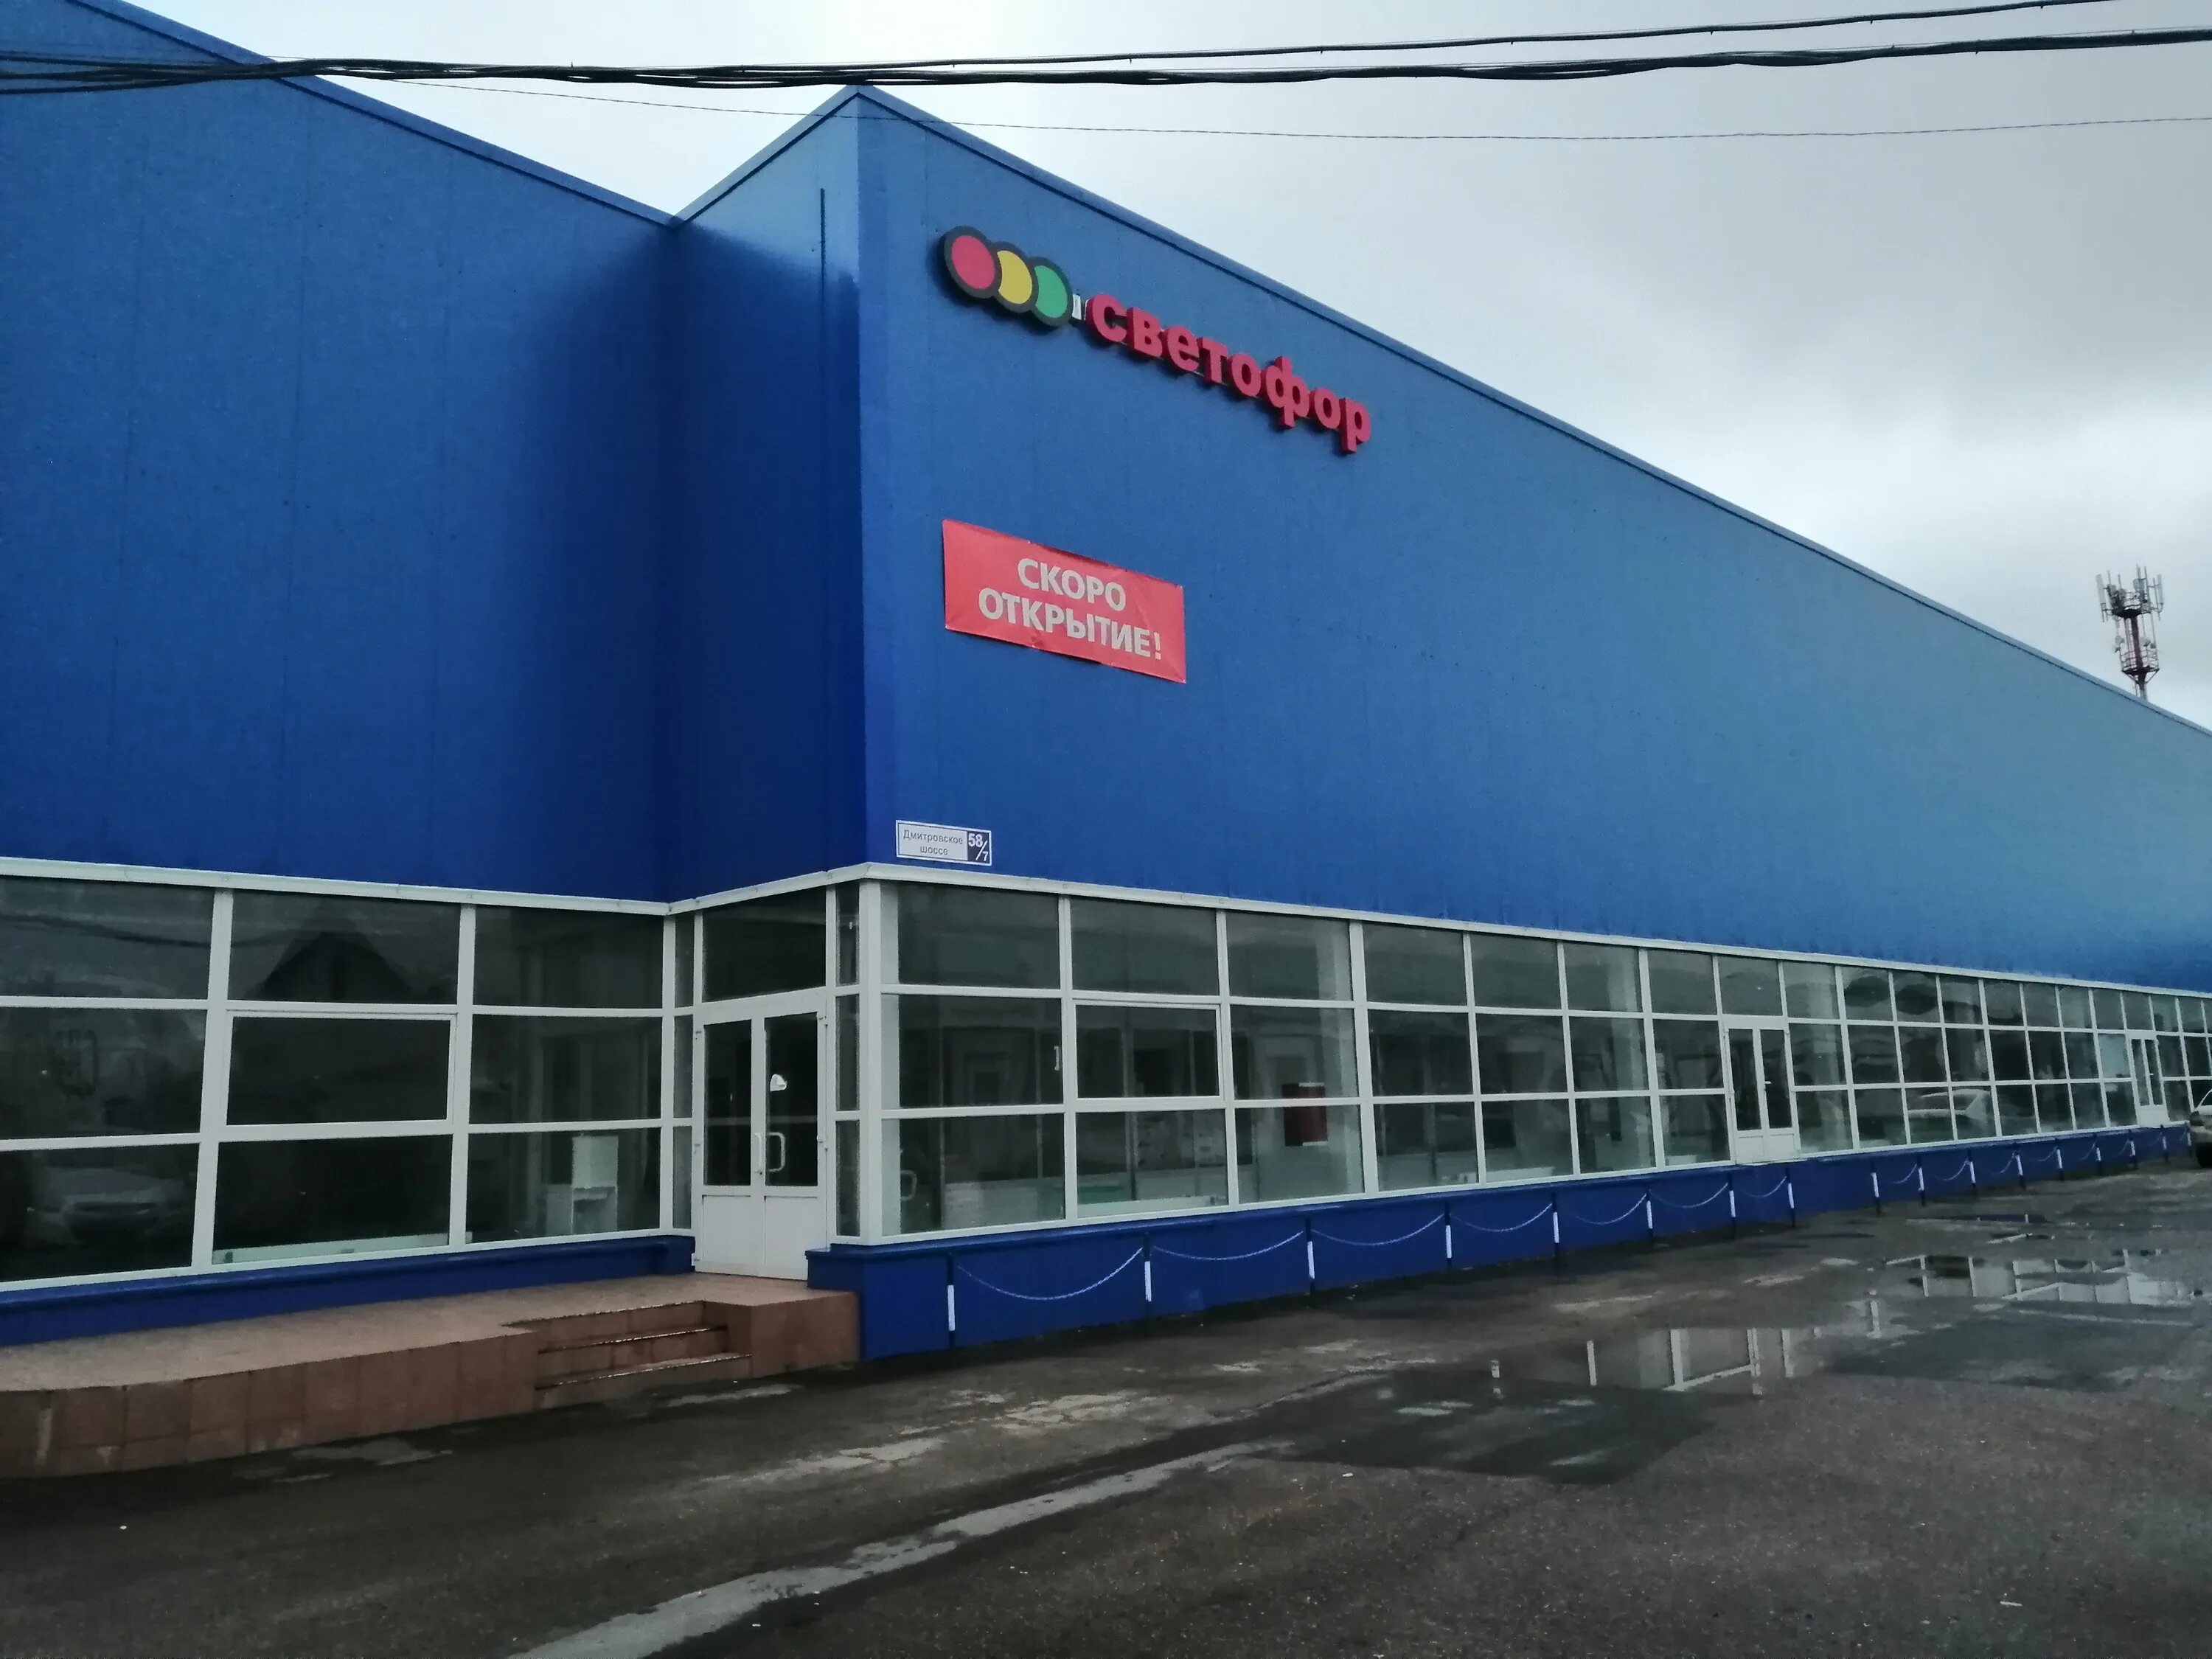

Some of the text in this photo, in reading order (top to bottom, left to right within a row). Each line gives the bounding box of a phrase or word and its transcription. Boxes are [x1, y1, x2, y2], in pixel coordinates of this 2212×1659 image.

[1087, 294, 1371, 453] светофор
[1018, 558, 1126, 611] СКОРО
[978, 588, 1161, 660] ОТКРЫТИЕ!
[903, 830, 963, 844] Дмитровское
[920, 846, 948, 855] шоссе
